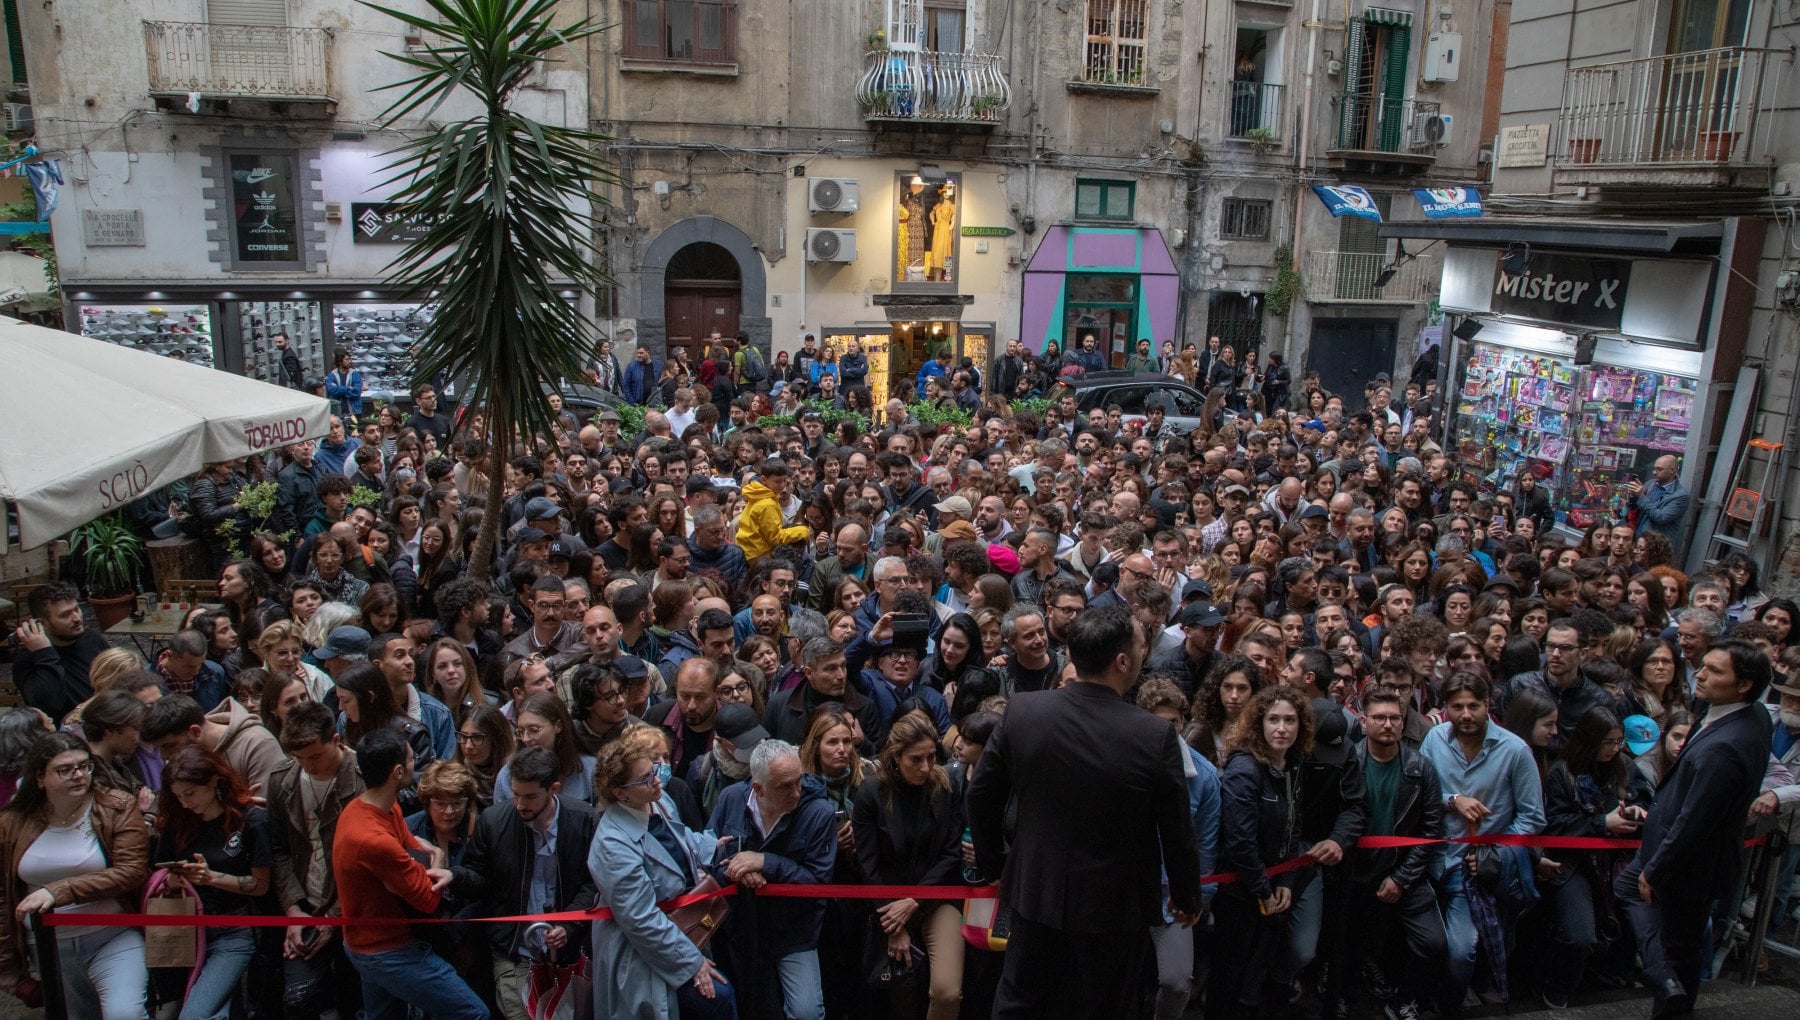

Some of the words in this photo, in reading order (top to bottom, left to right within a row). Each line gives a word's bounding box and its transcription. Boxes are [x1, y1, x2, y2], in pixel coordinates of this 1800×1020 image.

[1508, 129, 1540, 139] PIAZZETTA
[251, 167, 273, 177] NIKE
[86, 213, 100, 222] VIA
[105, 221, 130, 229] PORTA
[1495, 270, 1590, 305] Mister
[1594, 279, 1620, 309] X
[244, 416, 306, 451] TORALDO
[99, 459, 148, 510] SCIÒ
